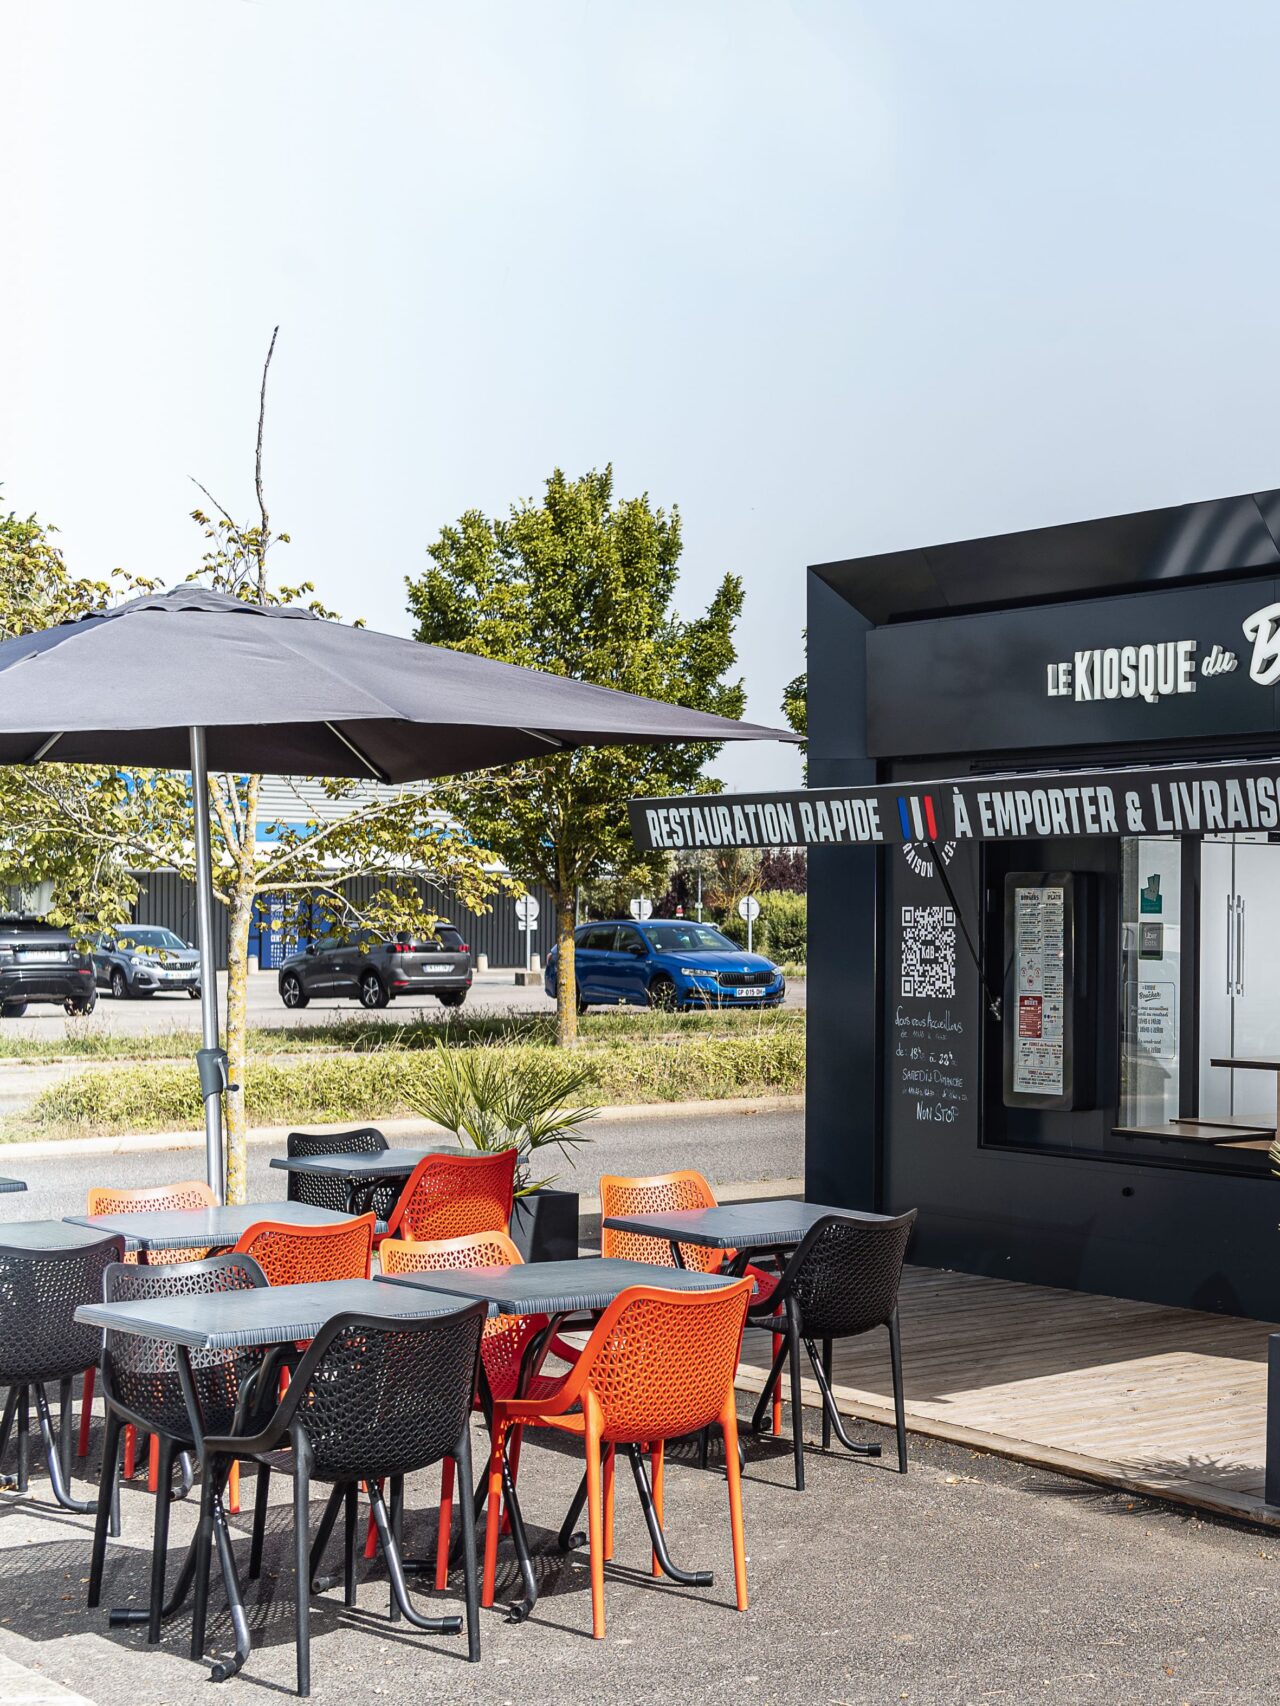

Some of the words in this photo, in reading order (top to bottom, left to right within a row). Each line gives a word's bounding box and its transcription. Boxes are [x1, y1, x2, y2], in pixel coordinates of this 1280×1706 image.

[1047, 663, 1072, 697] LE
[1074, 640, 1197, 703] KIOSQUE
[1201, 644, 1237, 678] du
[645, 801, 800, 848] RESTAURATION
[798, 798, 884, 844] RAPIDE
[952, 786, 973, 838] À
[977, 785, 1119, 837] EMPORTER
[1126, 791, 1146, 832] &
[921, 946, 935, 959] KdB
